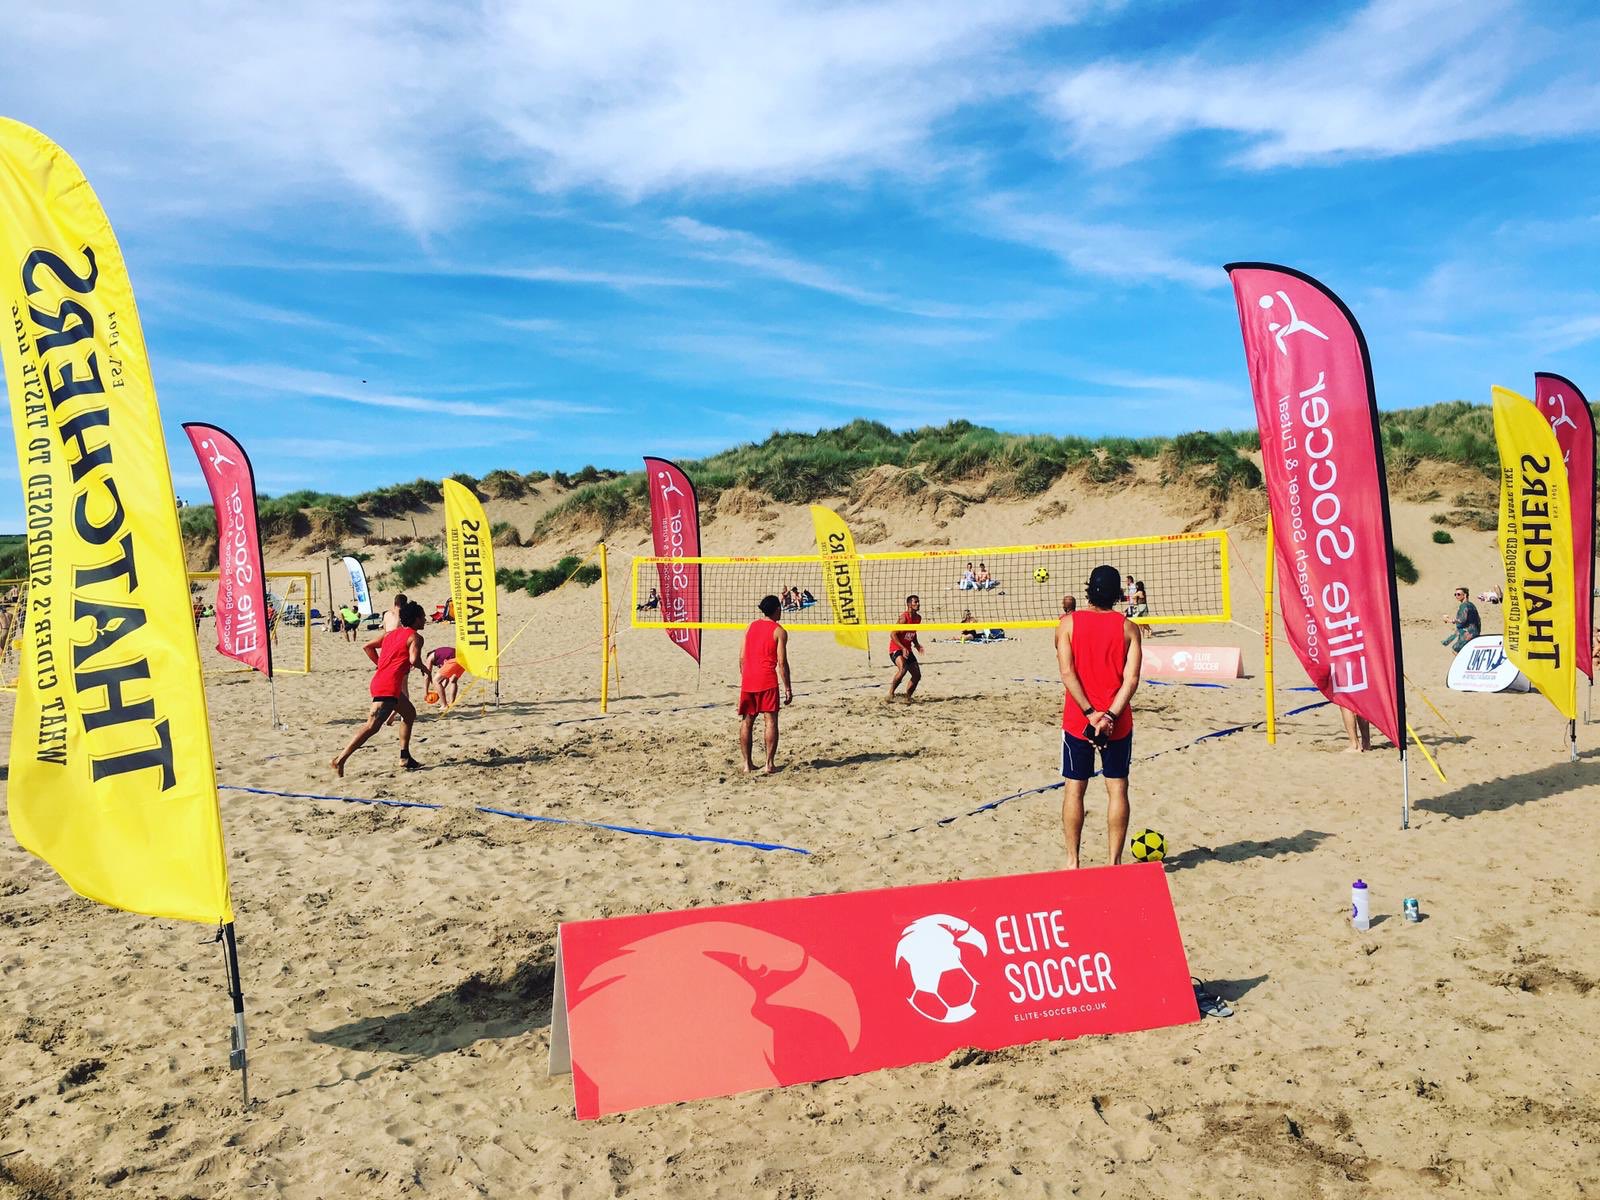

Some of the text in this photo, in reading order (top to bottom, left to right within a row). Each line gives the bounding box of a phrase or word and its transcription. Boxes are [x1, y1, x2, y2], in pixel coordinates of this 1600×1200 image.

[994, 909, 1069, 955] ELITE
[1004, 952, 1117, 1004] SOCCER
[1014, 1002, 1107, 1022] ELITE-SOCCER.CO.UK
